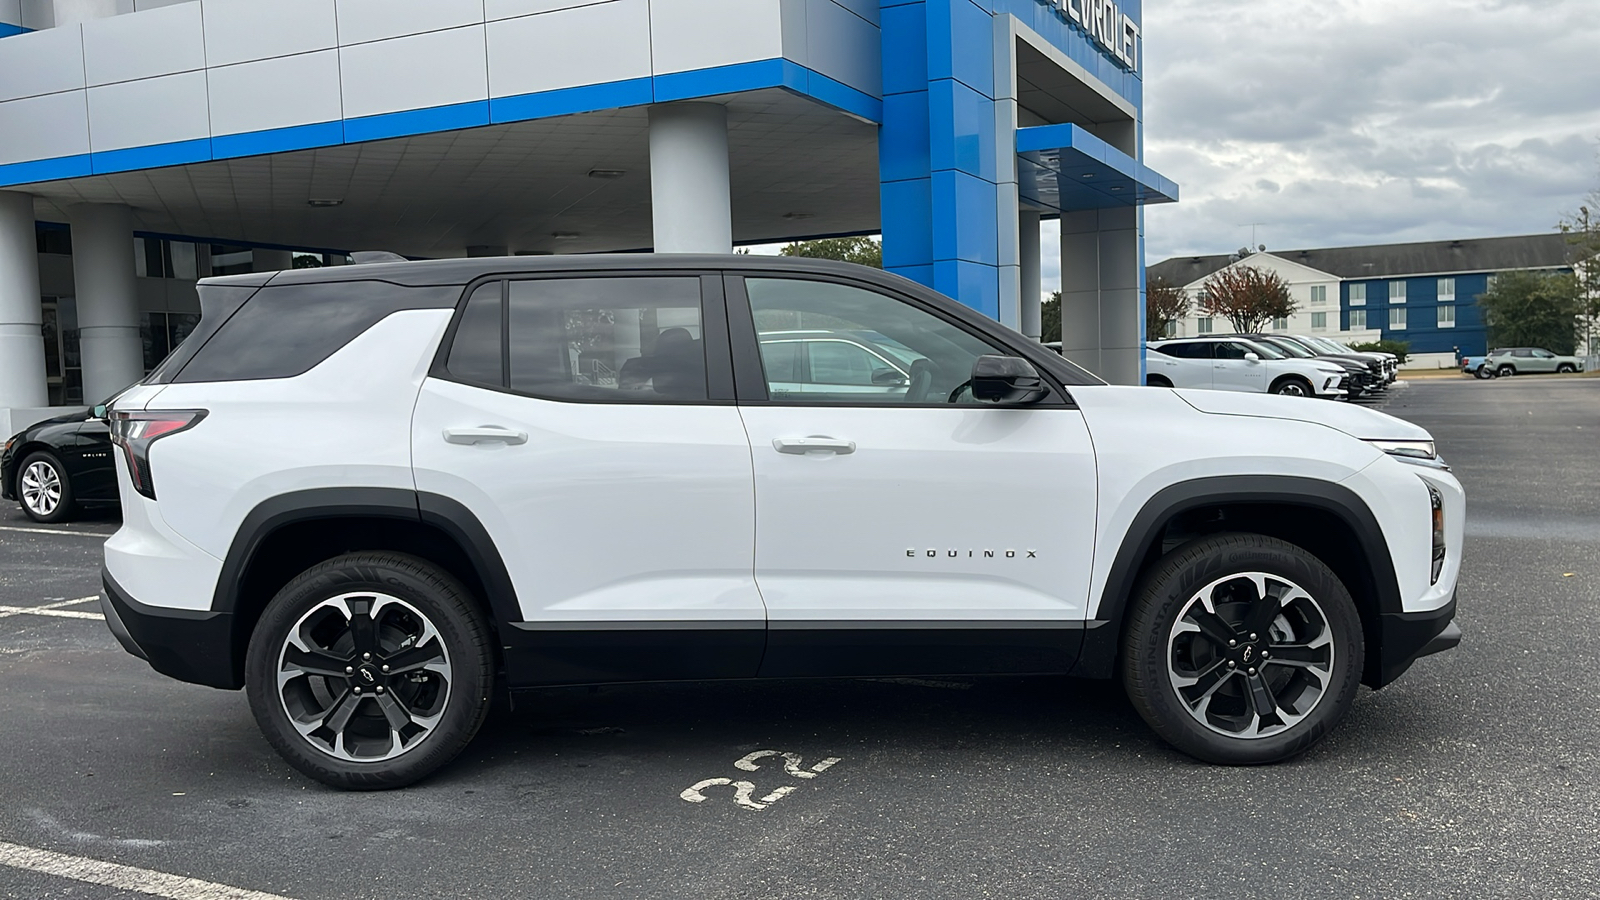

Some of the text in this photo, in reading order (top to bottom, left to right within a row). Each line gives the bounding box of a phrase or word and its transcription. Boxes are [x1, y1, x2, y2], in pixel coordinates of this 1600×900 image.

[1052, 0, 1139, 73] VROLET
[906, 549, 1037, 558] EQUINOX
[680, 750, 842, 811] 22
